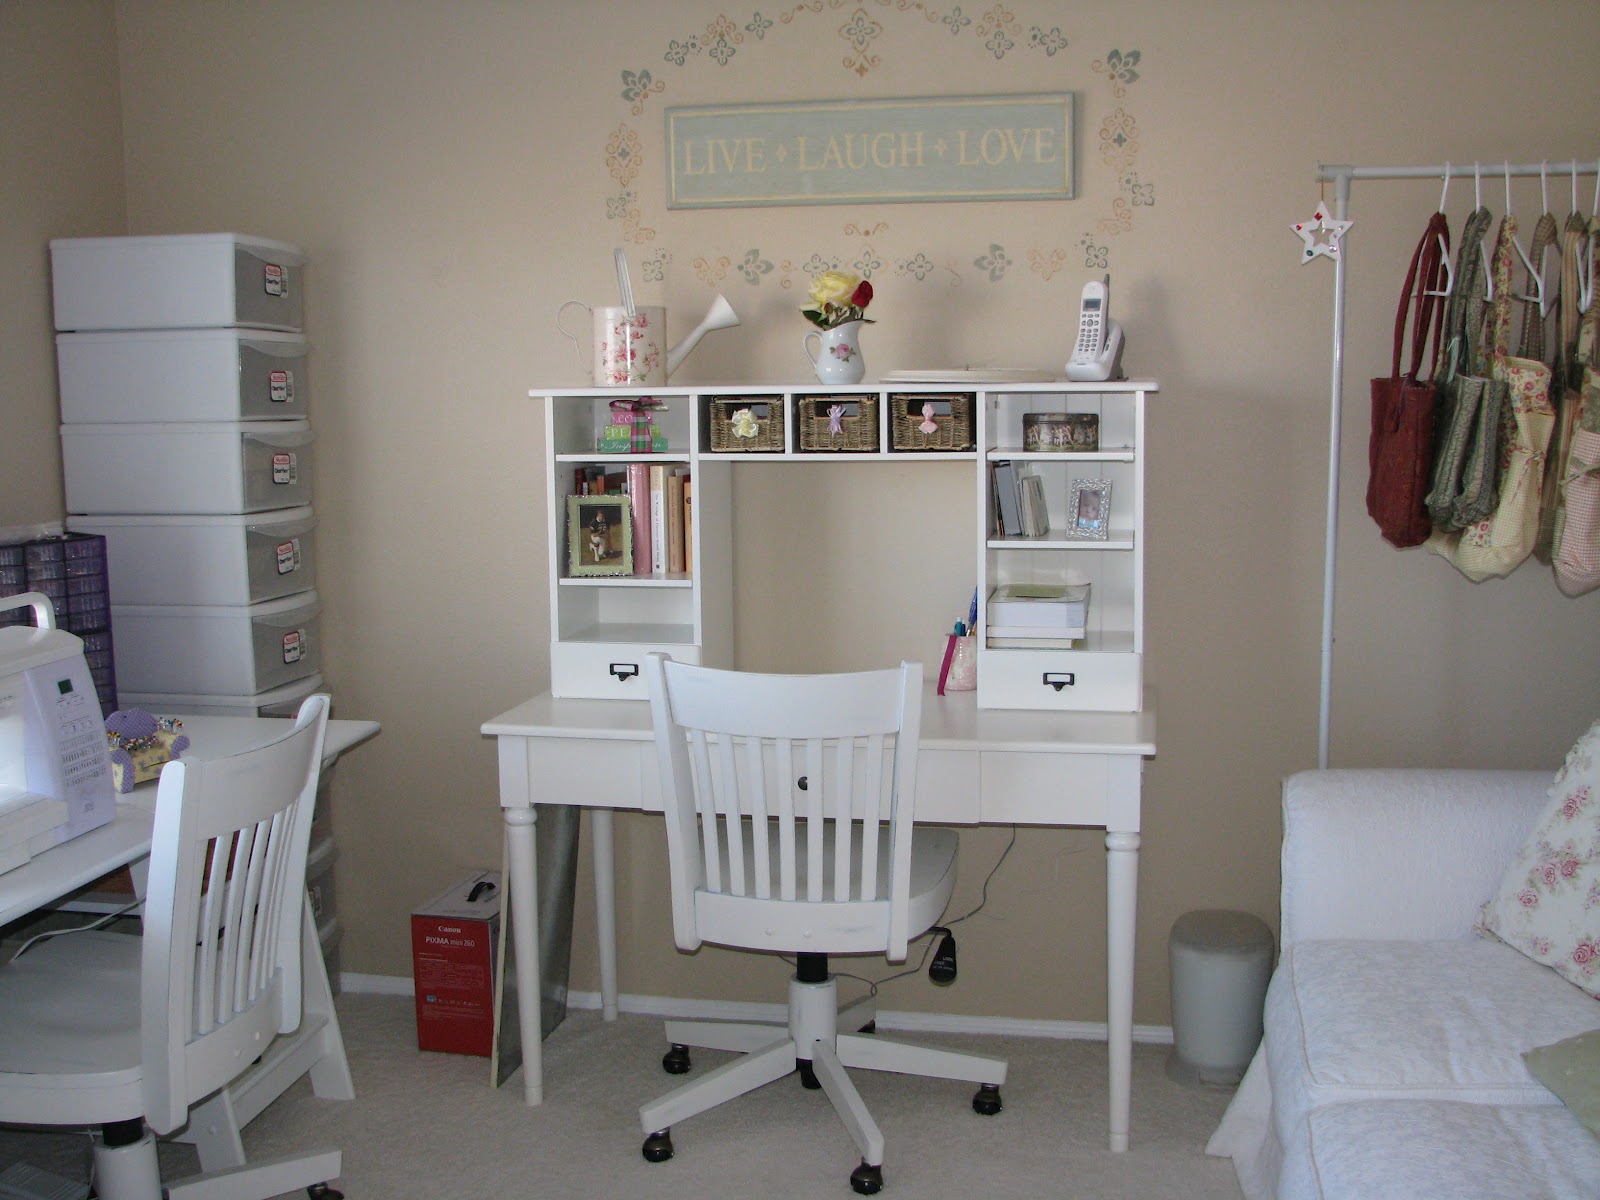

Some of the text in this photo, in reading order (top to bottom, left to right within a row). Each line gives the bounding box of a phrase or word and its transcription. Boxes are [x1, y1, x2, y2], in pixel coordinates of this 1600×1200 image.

[684, 127, 1056, 175] LIVE LAUGH LOVE
[425, 936, 450, 945] PIXMA
